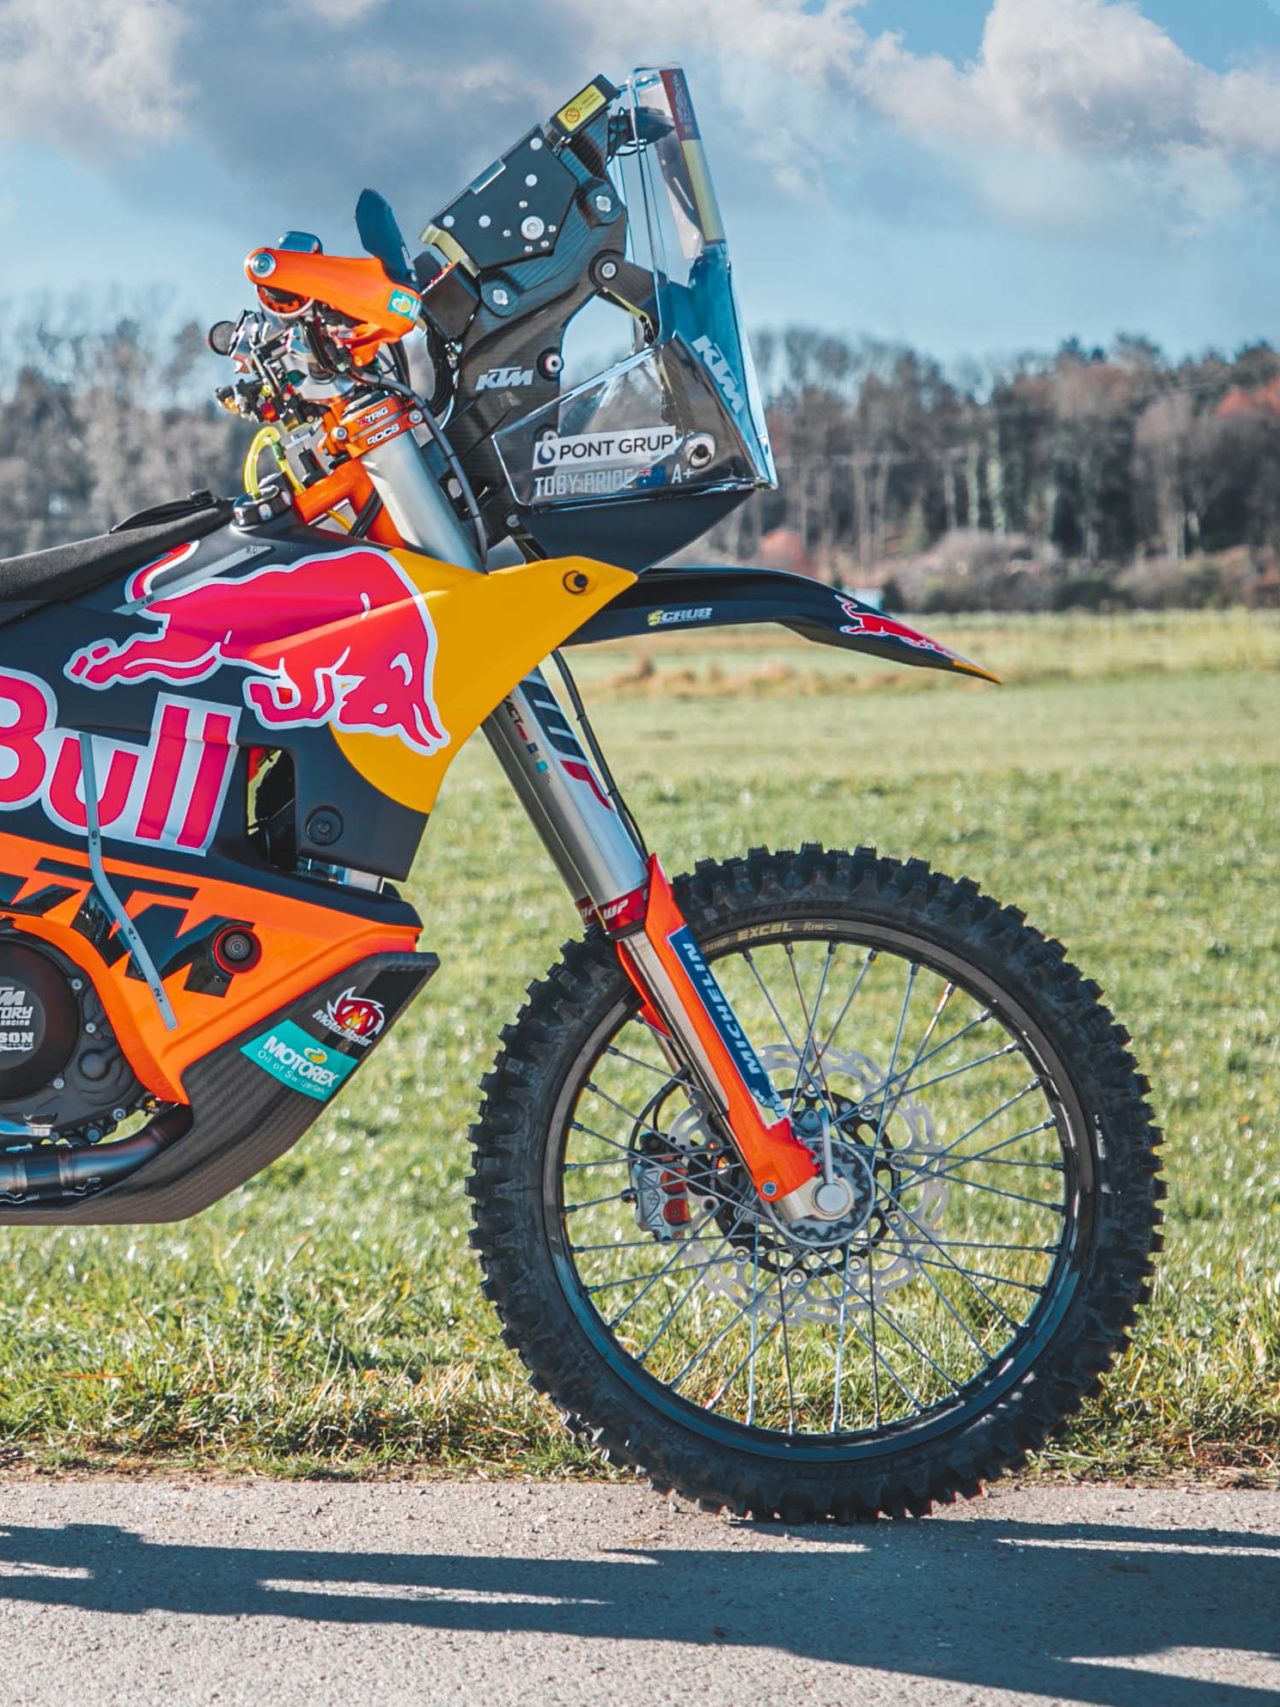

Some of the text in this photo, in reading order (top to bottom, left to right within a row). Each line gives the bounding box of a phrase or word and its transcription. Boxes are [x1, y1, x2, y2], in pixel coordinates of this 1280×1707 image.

[476, 366, 534, 391] KTM
[691, 335, 745, 415] KTM
[367, 423, 400, 445] ROCS
[559, 434, 674, 460] PONT GRUP
[534, 474, 578, 497] TOBY
[647, 607, 712, 626] SCRUB
[603, 898, 629, 919] WP
[736, 921, 794, 942] EXCEL
[682, 942, 762, 1075] MICHELIN
[257, 1049, 271, 1063] Oil
[273, 1062, 285, 1073] of
[263, 1035, 340, 1087] MOTOREX
